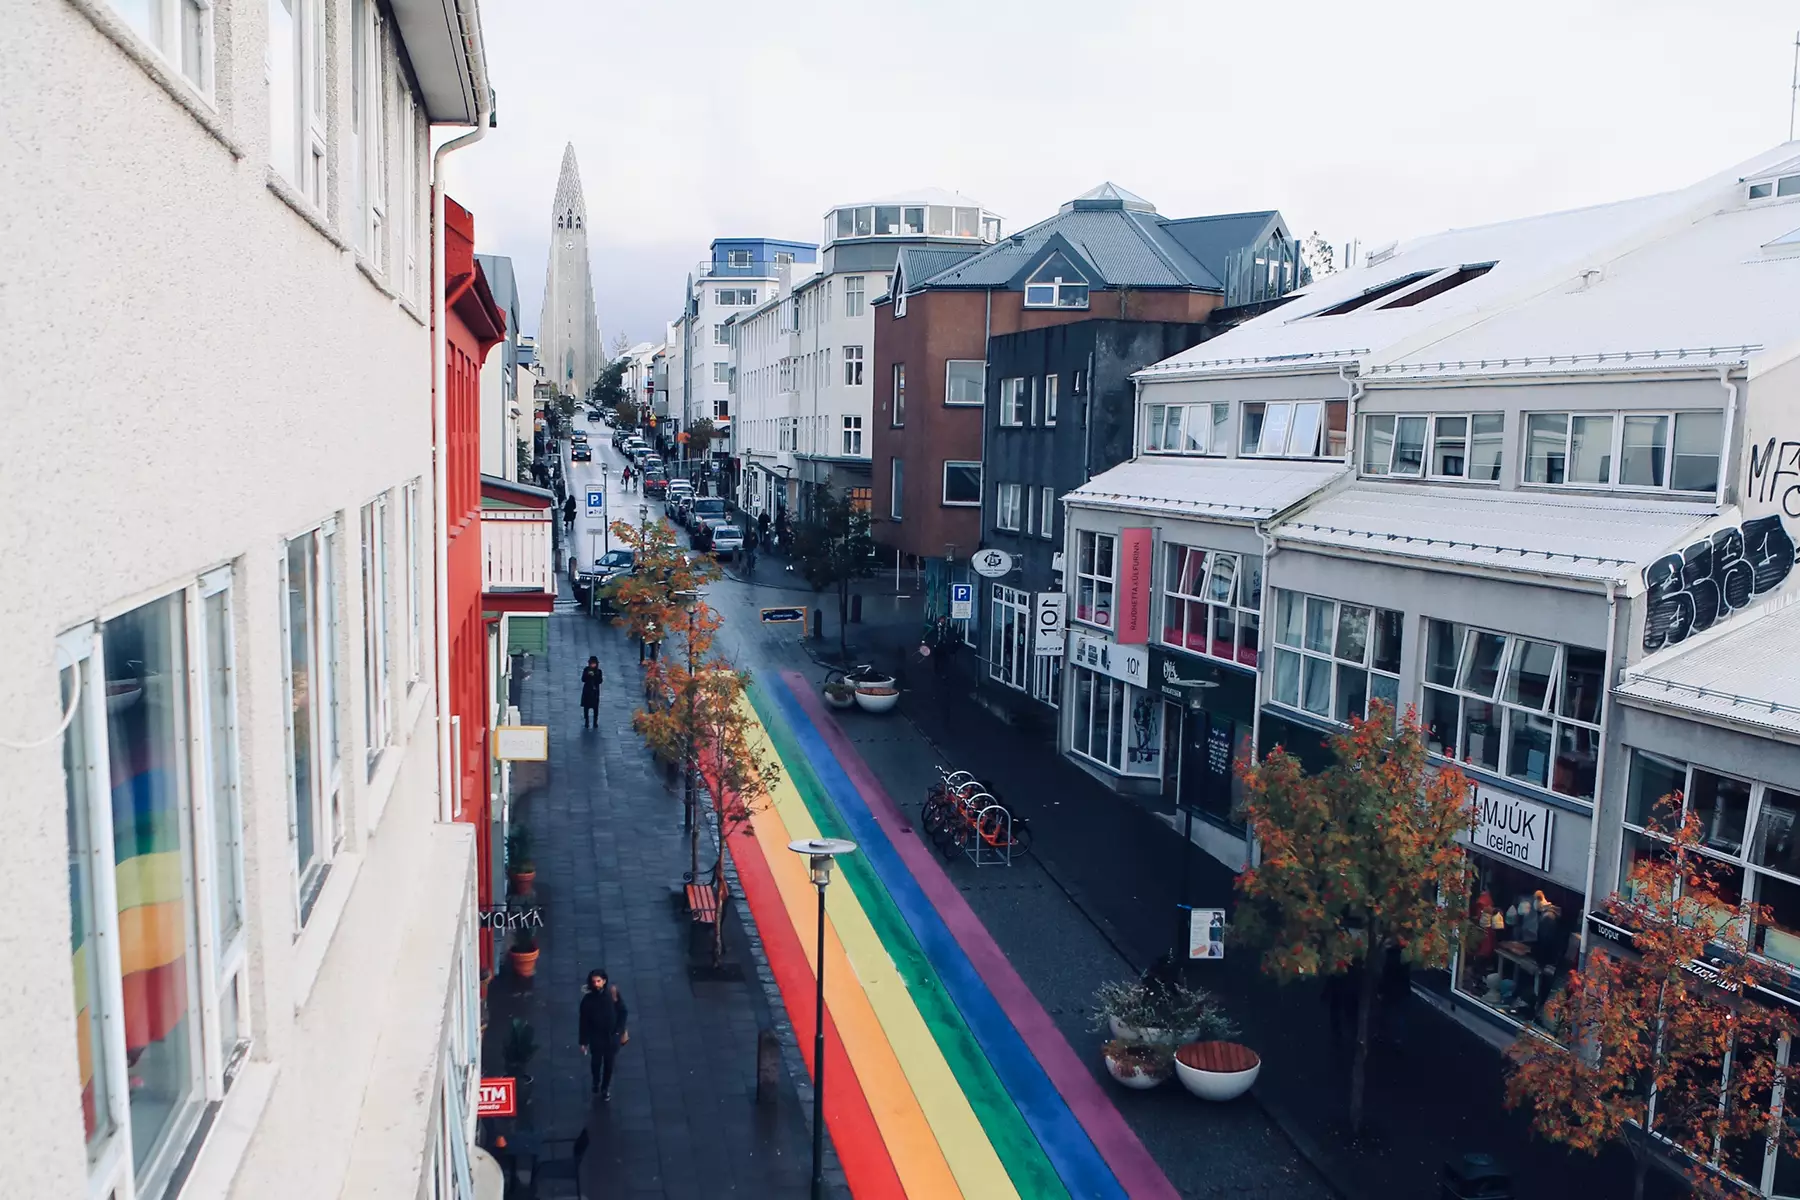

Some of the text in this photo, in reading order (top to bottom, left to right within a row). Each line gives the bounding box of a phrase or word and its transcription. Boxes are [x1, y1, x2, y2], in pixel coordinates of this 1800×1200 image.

[590, 494, 599, 505] P
[958, 588, 967, 599] P
[1482, 797, 1537, 841] MJÚK
[1486, 827, 1529, 860] Iceland
